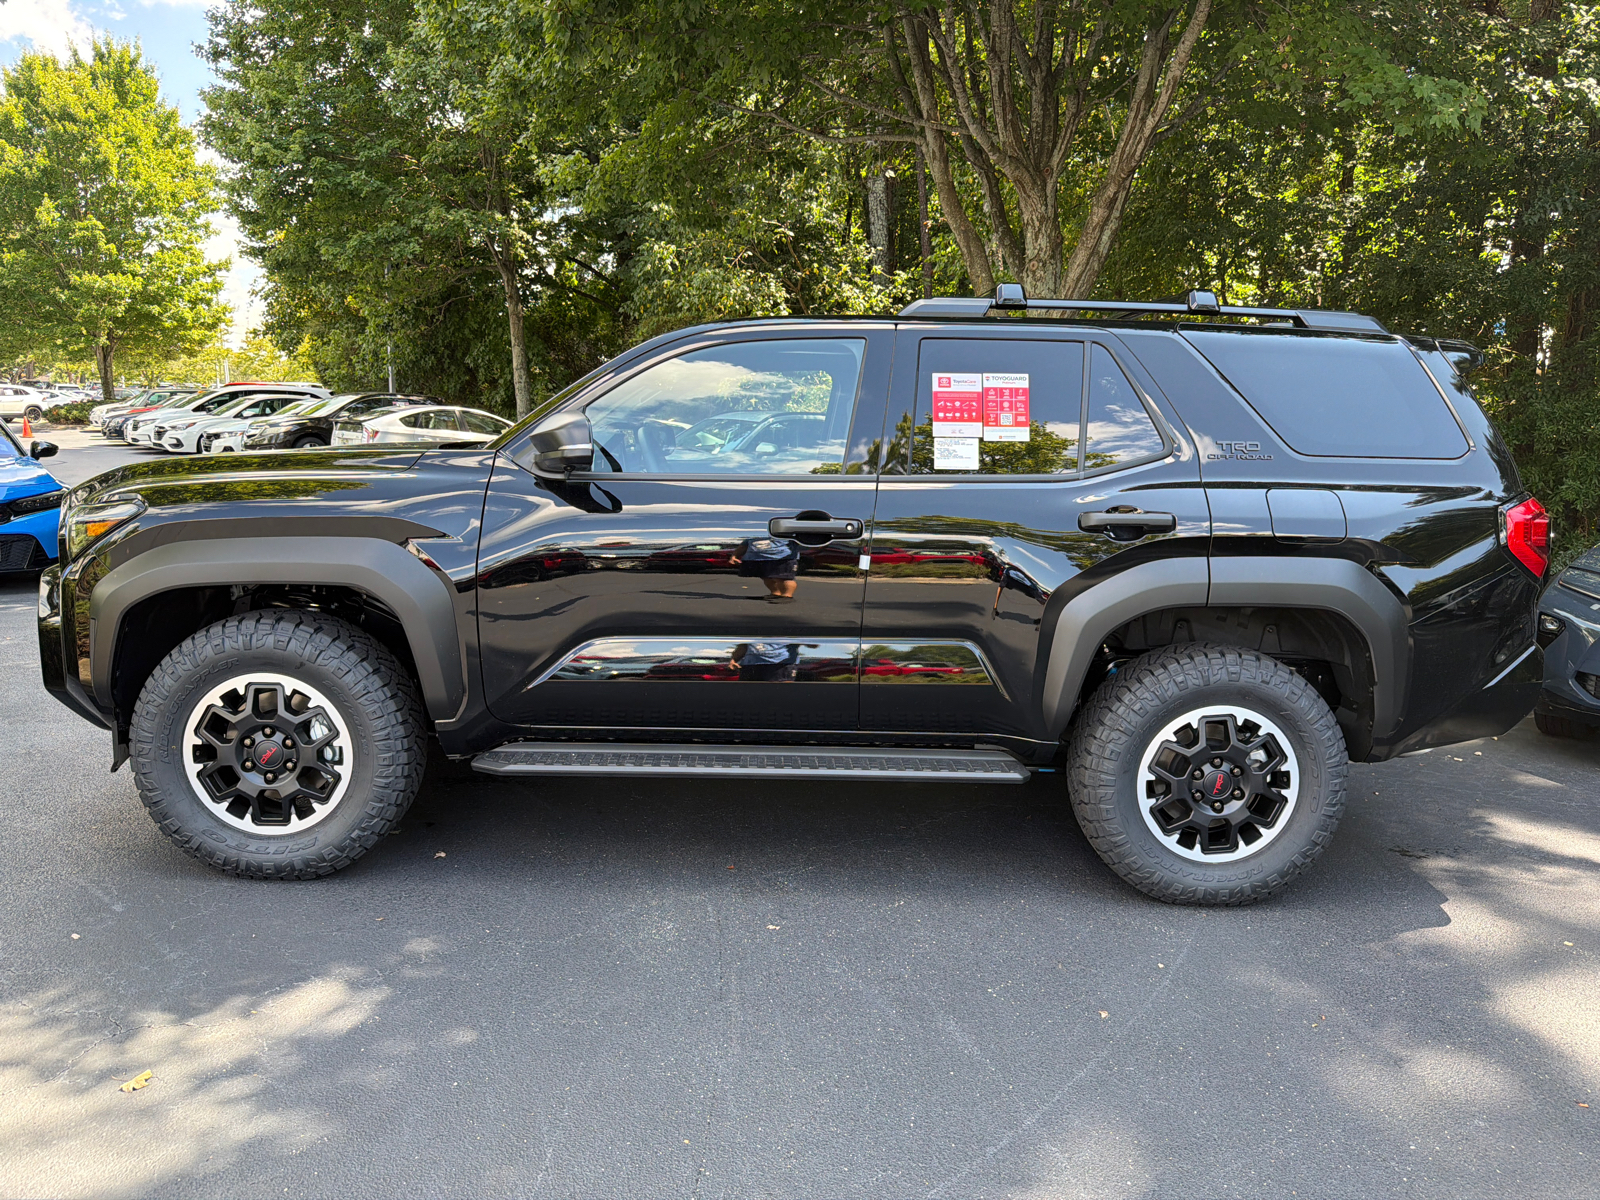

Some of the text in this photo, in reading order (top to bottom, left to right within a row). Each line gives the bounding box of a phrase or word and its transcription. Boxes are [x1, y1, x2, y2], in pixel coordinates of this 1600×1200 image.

[1216, 441, 1260, 454] TRD
[260, 746, 277, 764] TRD
[1212, 774, 1224, 795] TRD
[201, 829, 317, 855] NITTO
